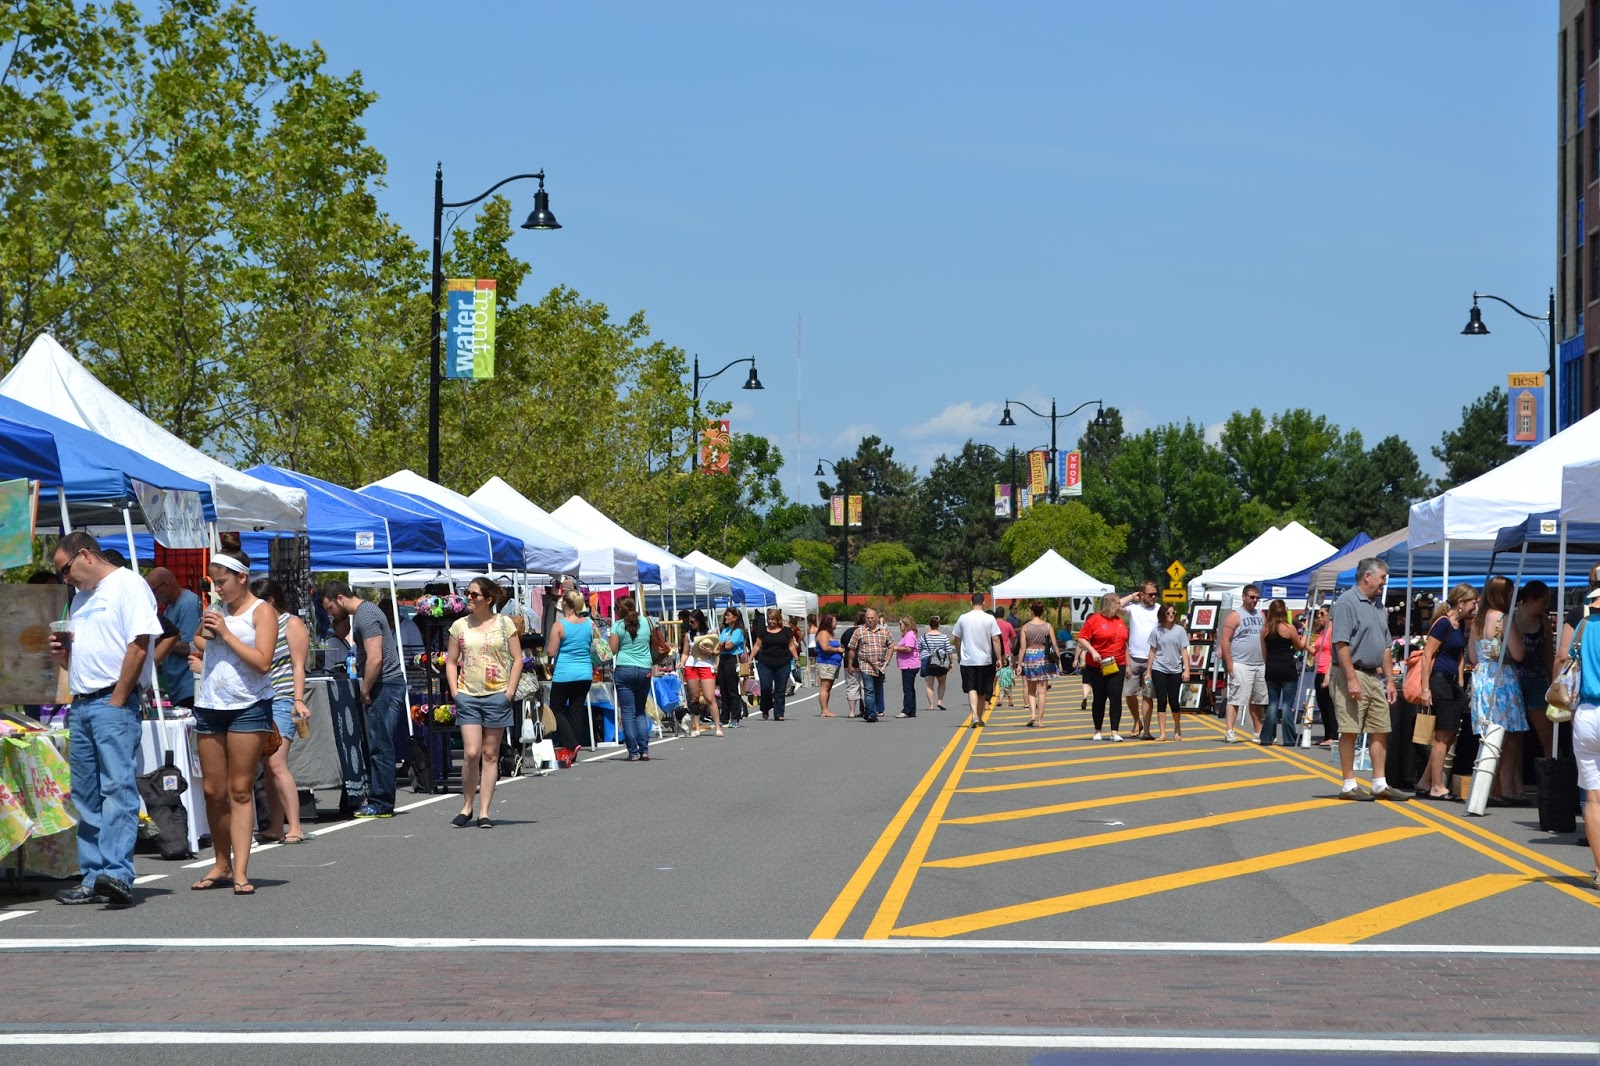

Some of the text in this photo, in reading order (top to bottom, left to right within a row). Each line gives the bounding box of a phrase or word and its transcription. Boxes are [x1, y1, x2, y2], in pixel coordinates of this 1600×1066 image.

[453, 299, 475, 372] water
[472, 287, 494, 355] front
[1513, 375, 1540, 386] nest
[1069, 455, 1077, 485] WORK
